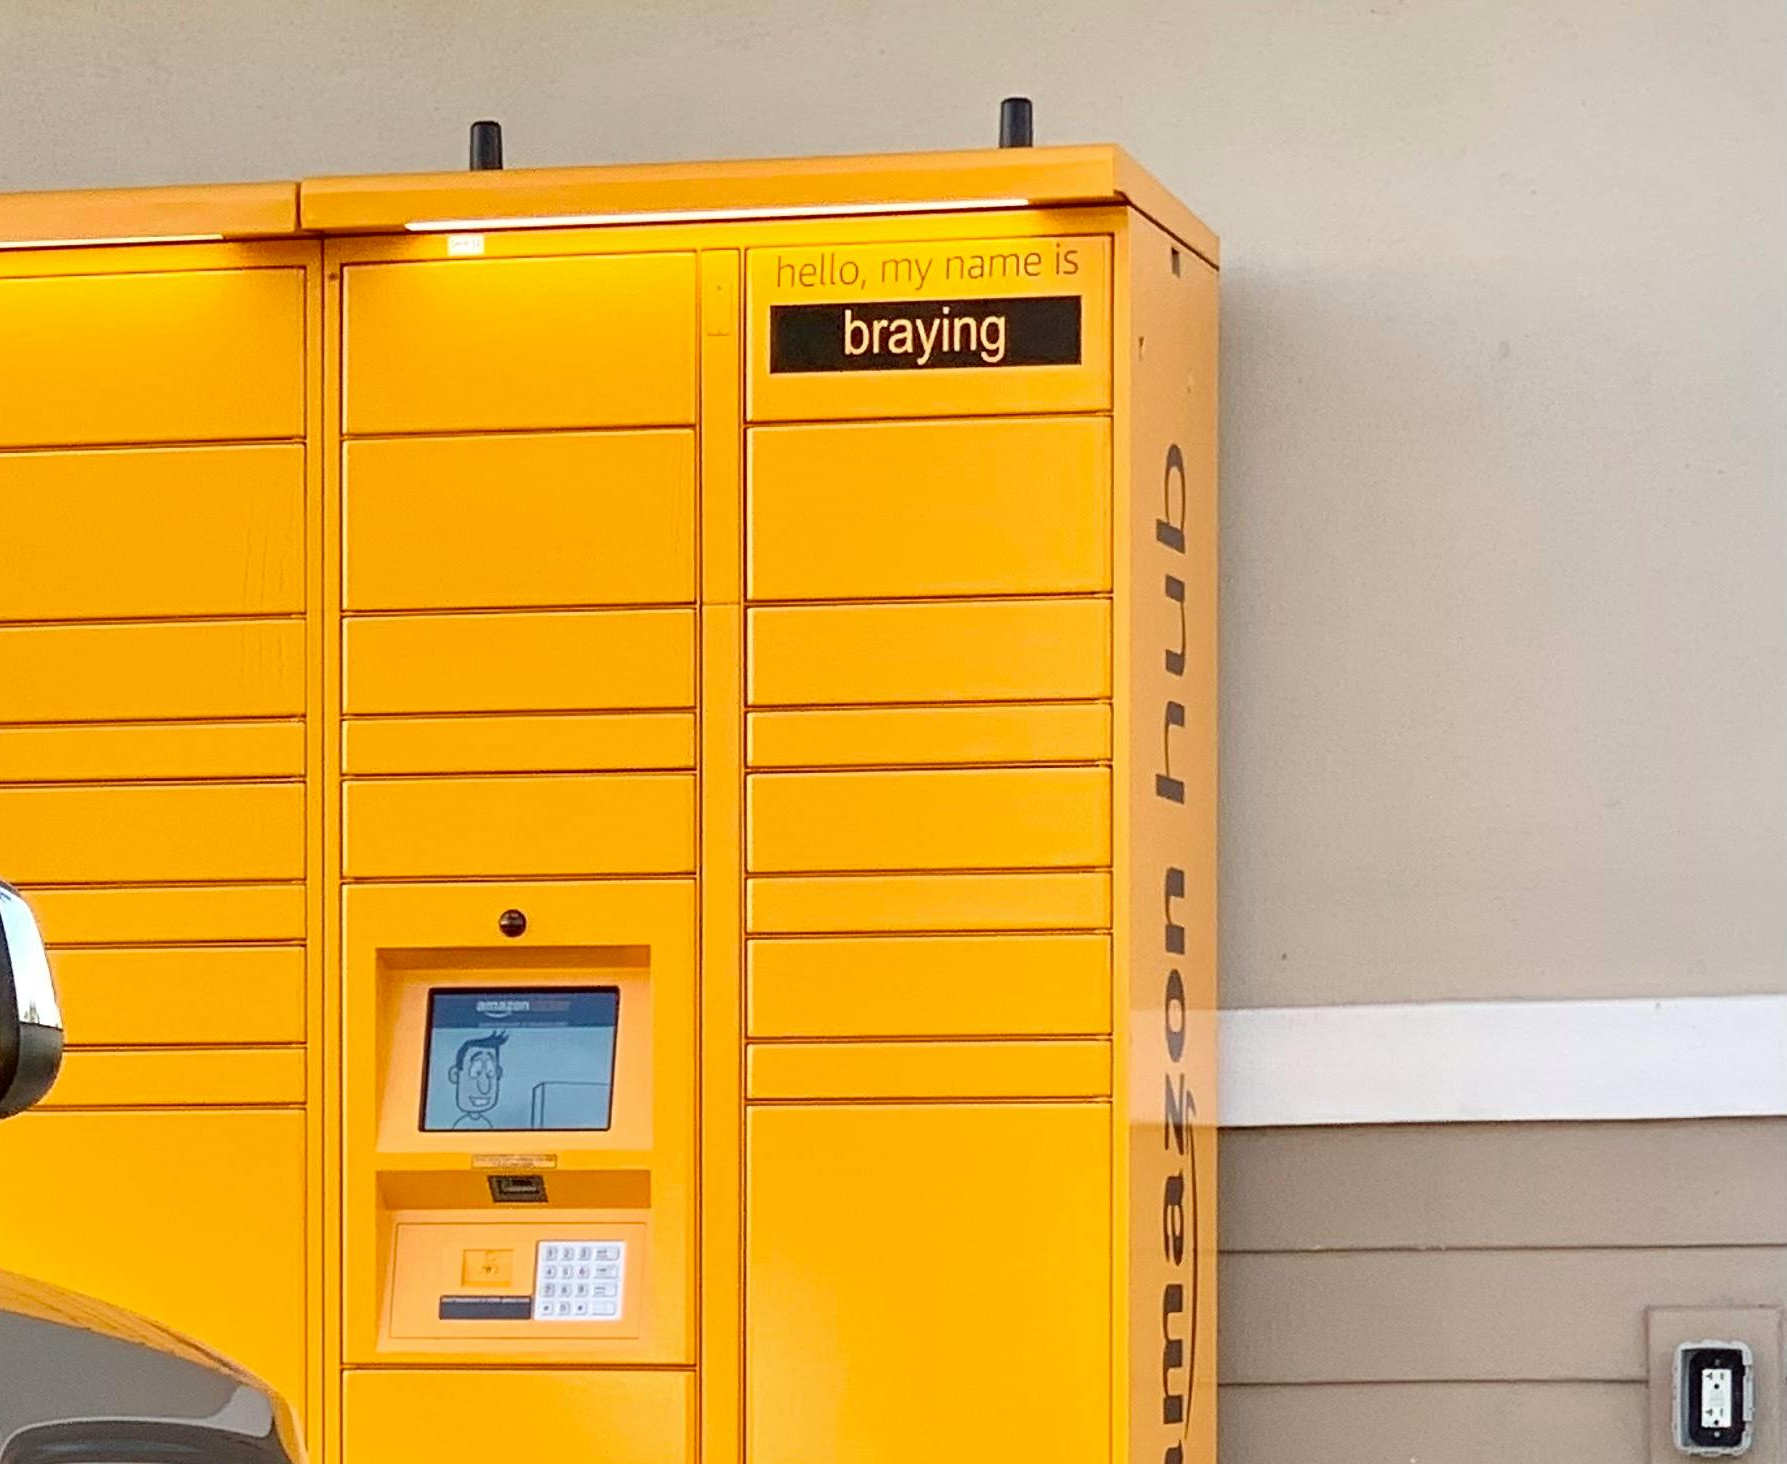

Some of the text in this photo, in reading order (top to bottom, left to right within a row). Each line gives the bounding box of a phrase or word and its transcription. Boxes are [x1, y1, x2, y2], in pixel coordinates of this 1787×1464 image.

[776, 242, 1080, 290] hello, my name is
[843, 306, 1007, 366] braying
[1155, 443, 1186, 805] hub
